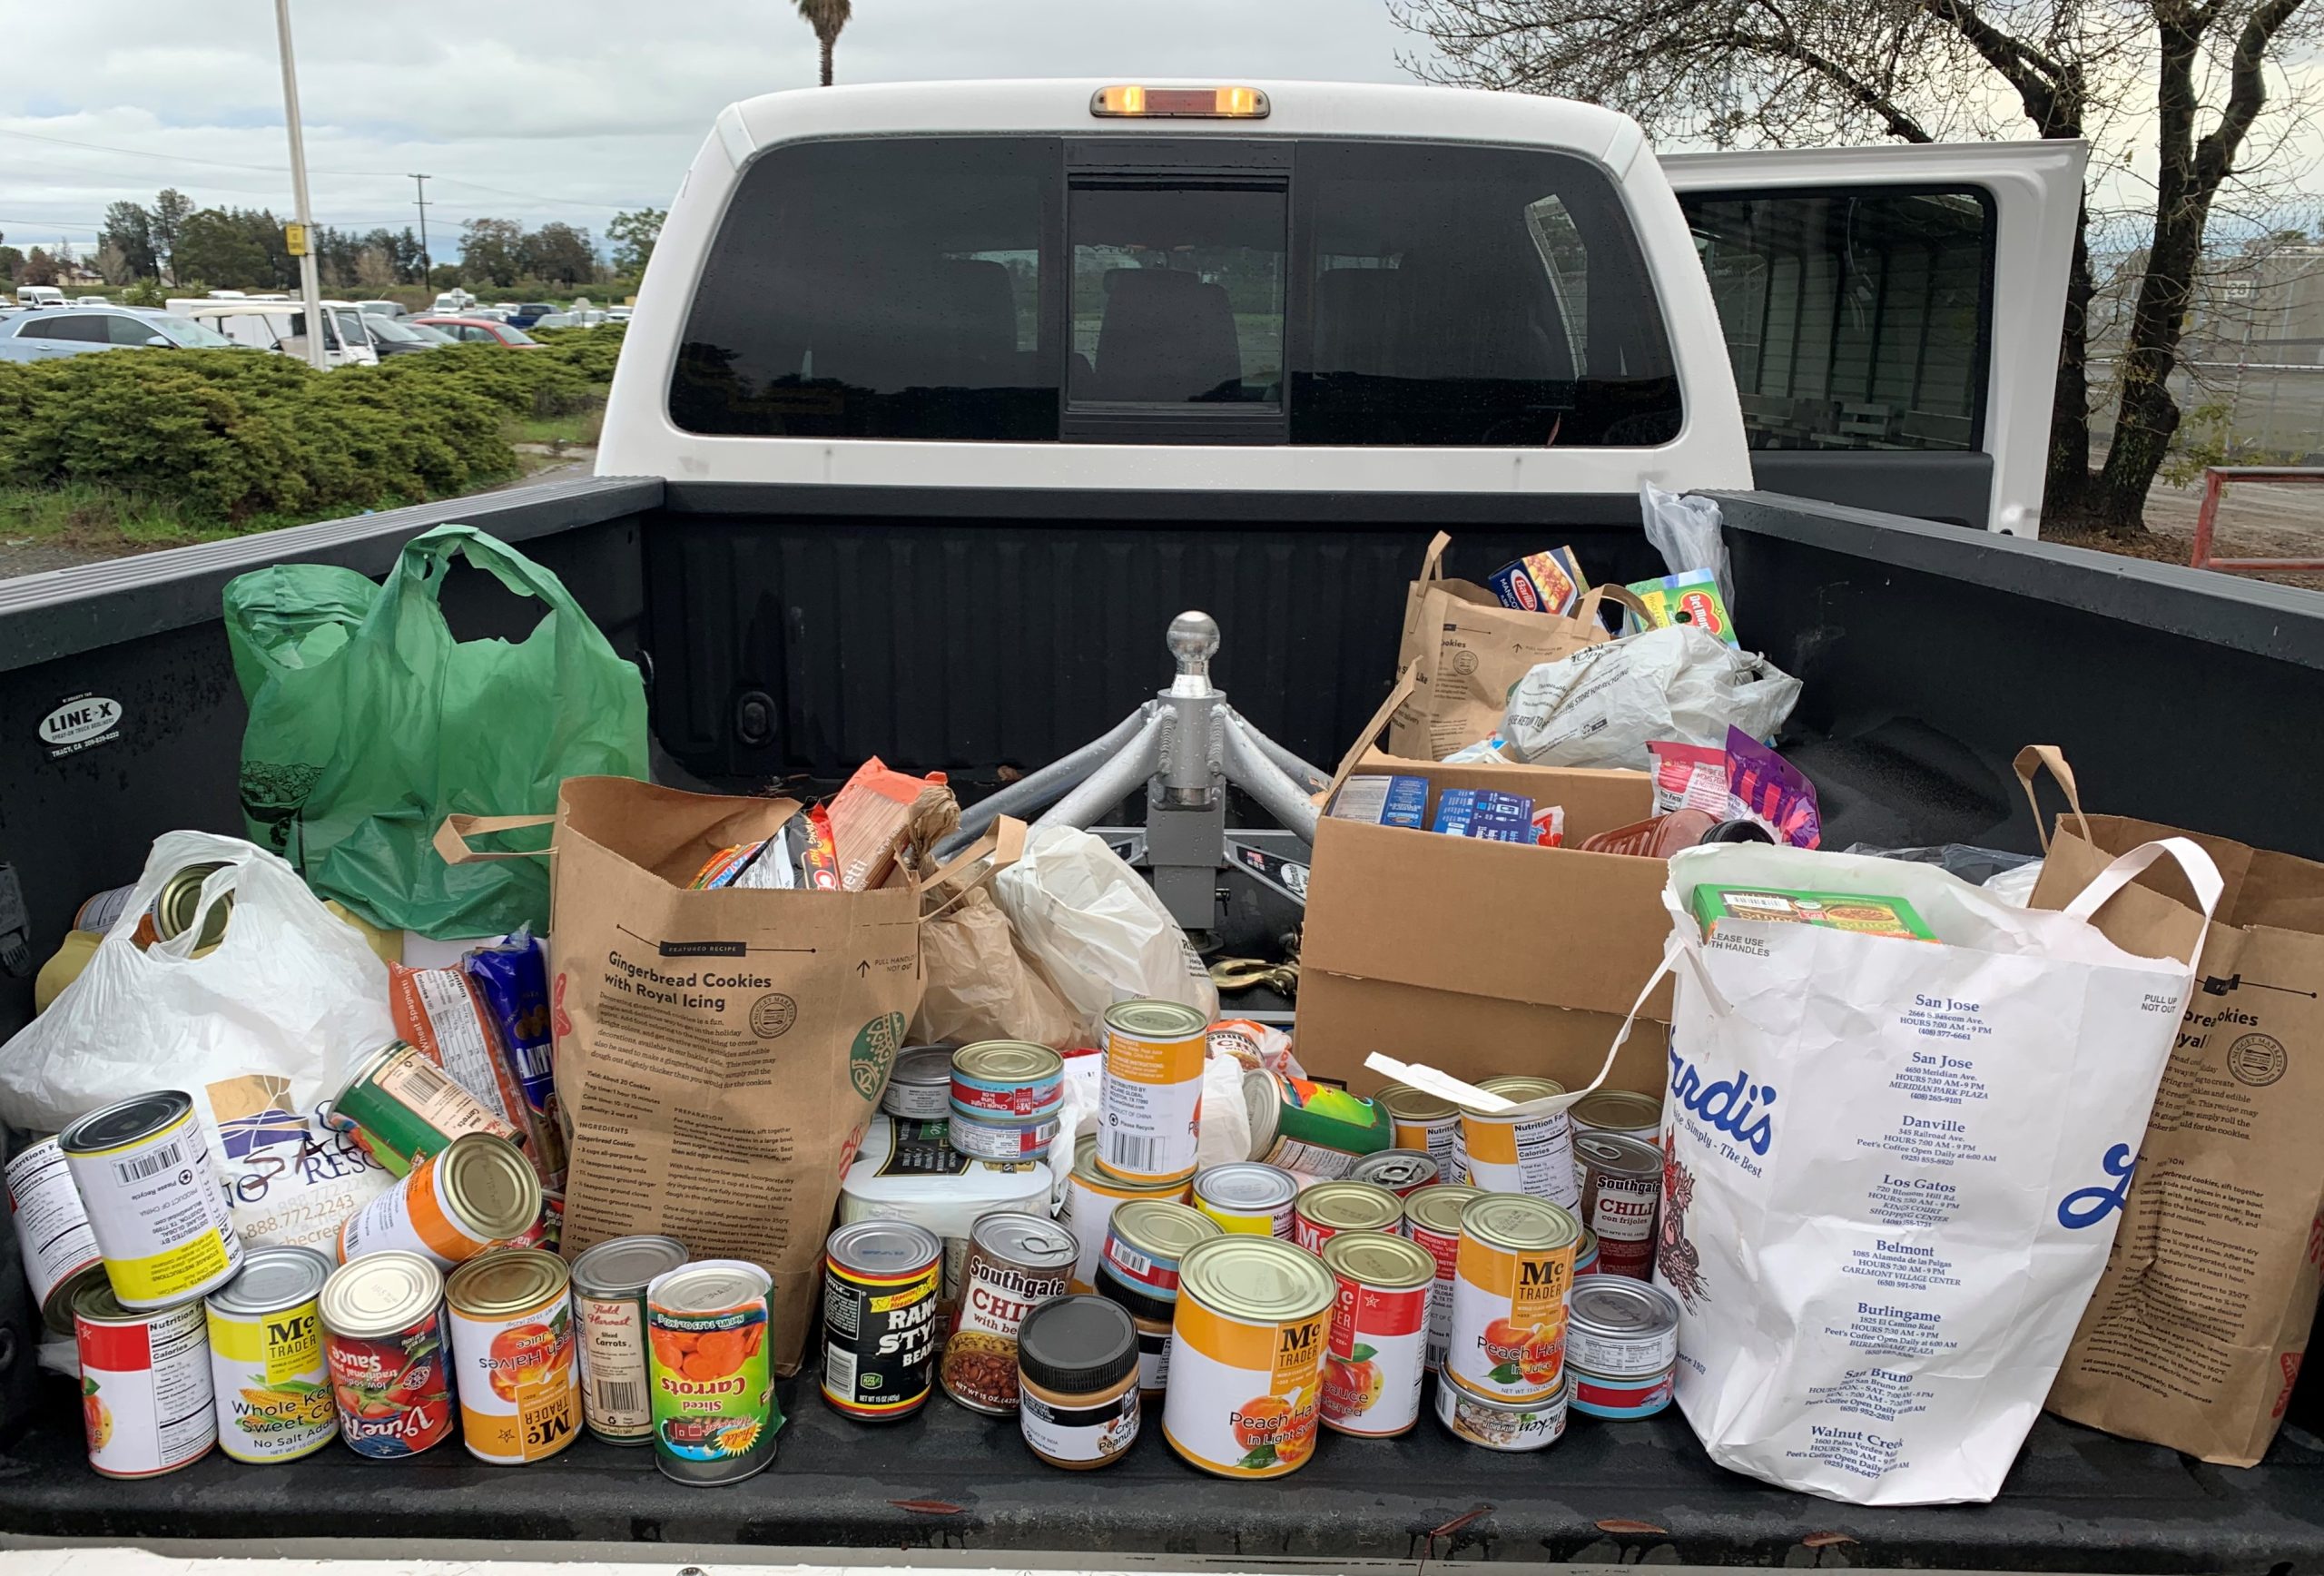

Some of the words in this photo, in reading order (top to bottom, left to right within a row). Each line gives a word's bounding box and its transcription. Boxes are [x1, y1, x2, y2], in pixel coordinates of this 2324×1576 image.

[1516, 580, 1535, 608] Barilla
[1689, 595, 1701, 610] Del
[1416, 671, 1427, 685] Like
[1575, 690, 1590, 706] STORE
[52, 745, 73, 757] TRACY,
[810, 849, 822, 867] HOT
[1725, 942, 1770, 957] HANDLES
[1744, 936, 1764, 947] USE
[608, 951, 697, 988] Gingerbread
[703, 972, 772, 988] Cookies
[605, 972, 632, 994] with
[636, 983, 677, 1005] Royal
[683, 994, 726, 1012] Icing
[2144, 994, 2166, 1004] PULL
[2168, 997, 2177, 1005] UP
[401, 979, 419, 1026] Spaghetti
[1915, 994, 1942, 1009] San
[1946, 998, 1980, 1012] Jose
[2141, 1003, 2160, 1012] NOT
[2161, 1004, 2175, 1013] OUT
[1900, 1017, 1931, 1028] HOURS
[1933, 1020, 1947, 1029] 7:00
[1949, 1022, 1965, 1030] AM
[1978, 1026, 1992, 1034] PM
[1908, 1010, 1925, 1019] 2666
[1966, 1017, 1984, 1025] Ave.
[1918, 1028, 1935, 1037] (408)
[1936, 1029, 1971, 1040] 377-6661
[1912, 1052, 1936, 1066] San
[1941, 1055, 1973, 1069] Jose
[1896, 1073, 1926, 1083] HOURS
[1927, 1076, 1943, 1085] 7:30
[1970, 1082, 1984, 1090] PM
[1905, 1066, 1922, 1075] 4650
[1923, 1068, 1957, 1079] Meridian
[1959, 1073, 1977, 1081] Ave.
[1889, 1080, 1935, 1093] MERIDIAN
[1934, 1087, 1959, 1096] PARK
[1960, 1089, 1988, 1099] PLAZA
[1910, 1092, 1927, 1100] (408)
[1929, 1094, 1963, 1105] 265-9101
[1135, 1123, 1155, 1131] Recycle
[1514, 1118, 1554, 1133] Nutrition
[1902, 1115, 1966, 1133] Danville
[1884, 1134, 1915, 1145] HOURS
[1918, 1138, 1933, 1147] 7:00
[1935, 1140, 1950, 1148] AM
[1962, 1144, 1975, 1152] PM
[1898, 1128, 1912, 1136] 345
[1914, 1128, 1946, 1140] Railroad
[1948, 1134, 1965, 1142] Ave.
[1519, 1147, 1550, 1157] Calories
[1685, 1119, 1712, 1148] Simply
[1719, 1143, 1740, 1163] The
[1740, 1155, 1763, 1178] Best
[1856, 1138, 1881, 1149] Peet's
[1883, 1143, 1910, 1153] Coffee
[1911, 1146, 1932, 1157] Open
[1934, 1148, 1955, 1159] Daily
[1982, 1154, 1996, 1162] AM
[1597, 1175, 1661, 1197] Southgate
[1884, 1174, 1910, 1188] Los
[1915, 1178, 1956, 1193] Gatos
[1600, 1199, 1656, 1216] CHILI
[244, 1194, 354, 1240] .888.772.2243
[1601, 1214, 1619, 1224] con
[1620, 1215, 1649, 1226] frijoles
[1876, 1239, 1934, 1257] Belmont
[1852, 1249, 1870, 1258] 1085
[1872, 1251, 1906, 1263] Alameda
[1928, 1258, 1952, 1268] Pulgas
[1858, 1258, 1891, 1270] HOURS
[1892, 1263, 1907, 1272] 7:30
[1909, 1266, 1924, 1274] AM
[970, 1254, 1065, 1301] Southgate
[1842, 1266, 1893, 1279] CARLMONT
[1894, 1272, 1927, 1283] VILLAGE
[1929, 1276, 1961, 1286] CENTER
[1877, 1278, 1896, 1287] (650)
[1896, 1281, 1926, 1291] 591-5768
[1520, 1284, 1562, 1301] TRADER
[593, 1303, 620, 1315] Field
[1857, 1302, 1942, 1323] Burlingame
[587, 1314, 632, 1328] Harvest
[693, 1321, 715, 1330] 14.25
[730, 1315, 744, 1324] Net
[974, 1313, 999, 1331] with
[1860, 1316, 1877, 1325] 1825
[1887, 1319, 1917, 1330] Camino
[1918, 1323, 1935, 1331] Real
[1851, 1323, 1883, 1334] HOURS
[1885, 1326, 1900, 1335] 7:30
[1899, 1328, 1915, 1336] AM
[269, 1335, 317, 1360] TRADER
[516, 1335, 547, 1349] Juice
[596, 1337, 627, 1347] Carrots
[1477, 1335, 1531, 1360] Peach
[1849, 1331, 1876, 1342] Coffee
[1877, 1335, 1898, 1345] Open
[1899, 1336, 1920, 1348] Daily
[331, 1345, 382, 1373] Sauce
[478, 1353, 543, 1373] Halves
[1279, 1345, 1318, 1367] TRADER
[345, 1367, 398, 1380] traditional
[1511, 1364, 1523, 1374] In
[1526, 1361, 1552, 1376] Juice
[1871, 1367, 1913, 1383] Bruno
[662, 1376, 745, 1396] Carrots
[955, 1381, 967, 1392] NET
[967, 1387, 979, 1396] WT
[231, 1401, 297, 1416] Whole
[525, 1394, 569, 1425] TRADER
[683, 1401, 723, 1412] Sliced
[241, 1415, 304, 1433] Sweet
[361, 1406, 434, 1438] Vine
[1229, 1412, 1288, 1429] Peach
[254, 1440, 272, 1448] No
[277, 1434, 301, 1446] Salt
[1098, 1427, 1133, 1450] Peanut
[1248, 1434, 1260, 1445] In
[1264, 1431, 1294, 1444] Light
[1811, 1425, 1864, 1441] Walnut
[1867, 1434, 1904, 1450] Creek
[1824, 1459, 1844, 1470] (925)
[1845, 1463, 1880, 1480] 939-6477
